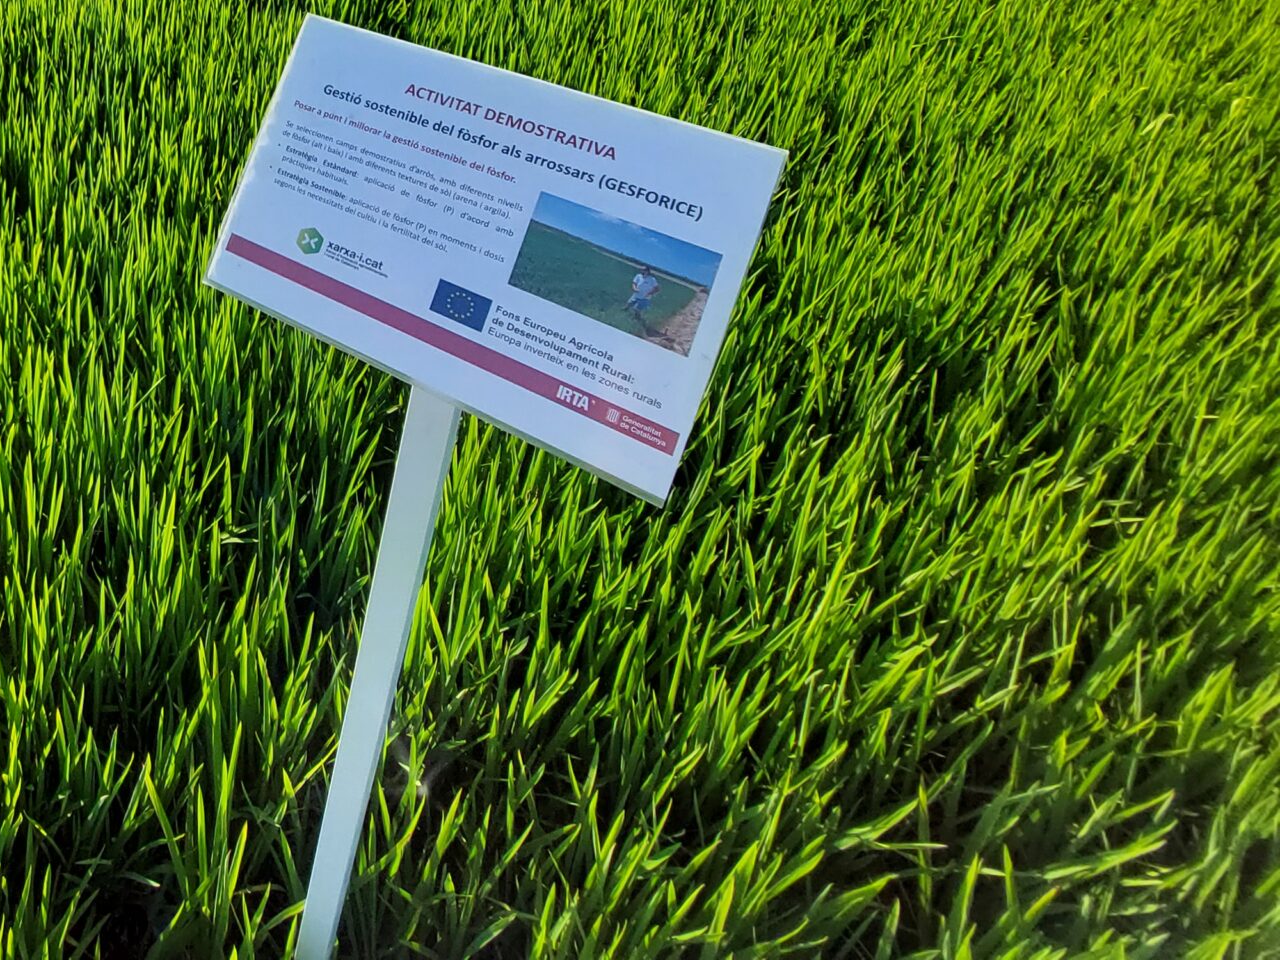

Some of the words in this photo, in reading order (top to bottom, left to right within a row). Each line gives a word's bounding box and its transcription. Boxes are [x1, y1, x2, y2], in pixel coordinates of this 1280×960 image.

[293, 99, 317, 113] Posar
[322, 111, 343, 123] punt
[348, 119, 383, 136] millorar
[382, 129, 392, 140] la
[391, 135, 420, 150] gestió
[420, 145, 468, 167] sostenible
[468, 160, 486, 173] del
[486, 166, 516, 184] fòsfor.
[323, 84, 362, 106] Gestió
[363, 99, 430, 128] sostenible
[432, 120, 456, 137] del
[456, 127, 500, 151] fòsfor
[500, 144, 522, 159] als
[524, 153, 595, 183] arrossars
[598, 174, 703, 222] (GESFORICE)
[404, 83, 483, 116] ACTIVITAT
[483, 107, 616, 161] DEMOSTRATIVA
[285, 120, 295, 129] Se
[295, 124, 334, 143] seleccionen
[335, 139, 358, 152] camps
[359, 147, 407, 169] demostratius
[438, 176, 457, 188] amb
[459, 183, 495, 202] diferents
[497, 197, 524, 212] nivells
[487, 326, 522, 348] Europa
[523, 341, 565, 367] inverteix
[565, 362, 580, 373] en
[581, 367, 597, 381] les
[598, 376, 630, 396] zones
[632, 391, 663, 410] rurals
[491, 317, 505, 328] de
[506, 321, 600, 370] Desenvolupament
[601, 362, 635, 385] Rural:
[495, 304, 521, 322] Fons
[522, 316, 567, 342] Europeu
[567, 336, 614, 362] Agrícola
[556, 384, 590, 412] IRTA
[619, 421, 630, 430] de
[631, 426, 667, 447] Catalunya
[622, 415, 662, 437] Generalitat
